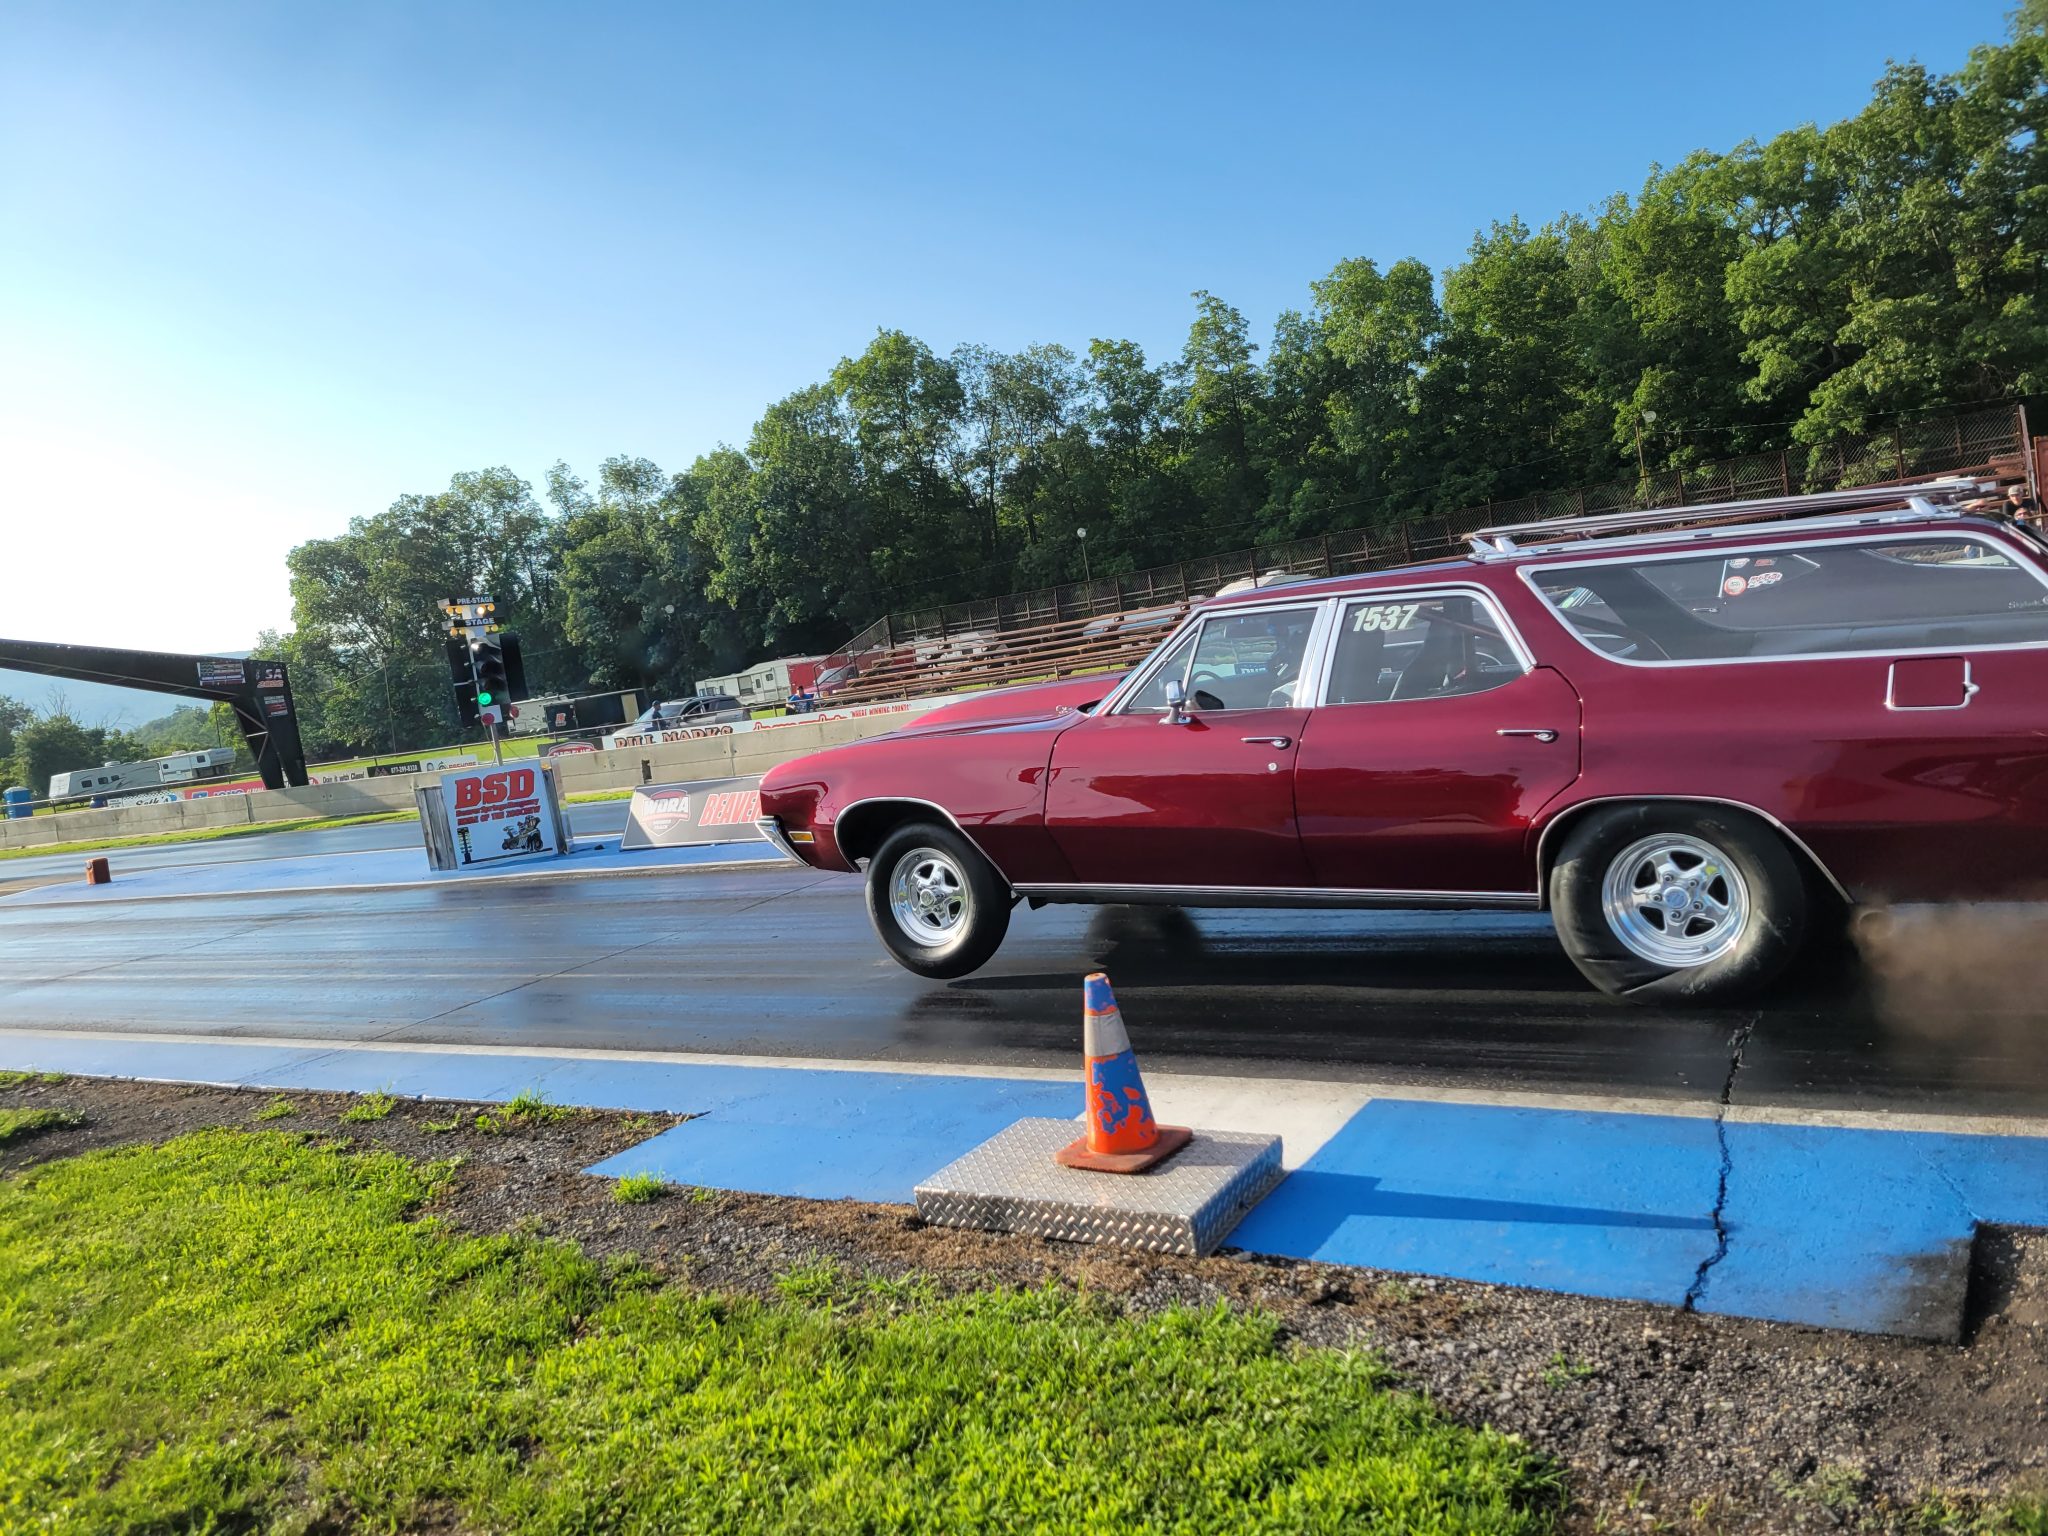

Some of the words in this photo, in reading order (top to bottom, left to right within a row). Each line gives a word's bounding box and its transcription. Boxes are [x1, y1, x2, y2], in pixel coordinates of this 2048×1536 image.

[457, 596, 494, 604] PRE-STAGE
[466, 618, 495, 626] STAGE
[1353, 605, 1419, 631] 1537
[454, 768, 535, 809] BSD
